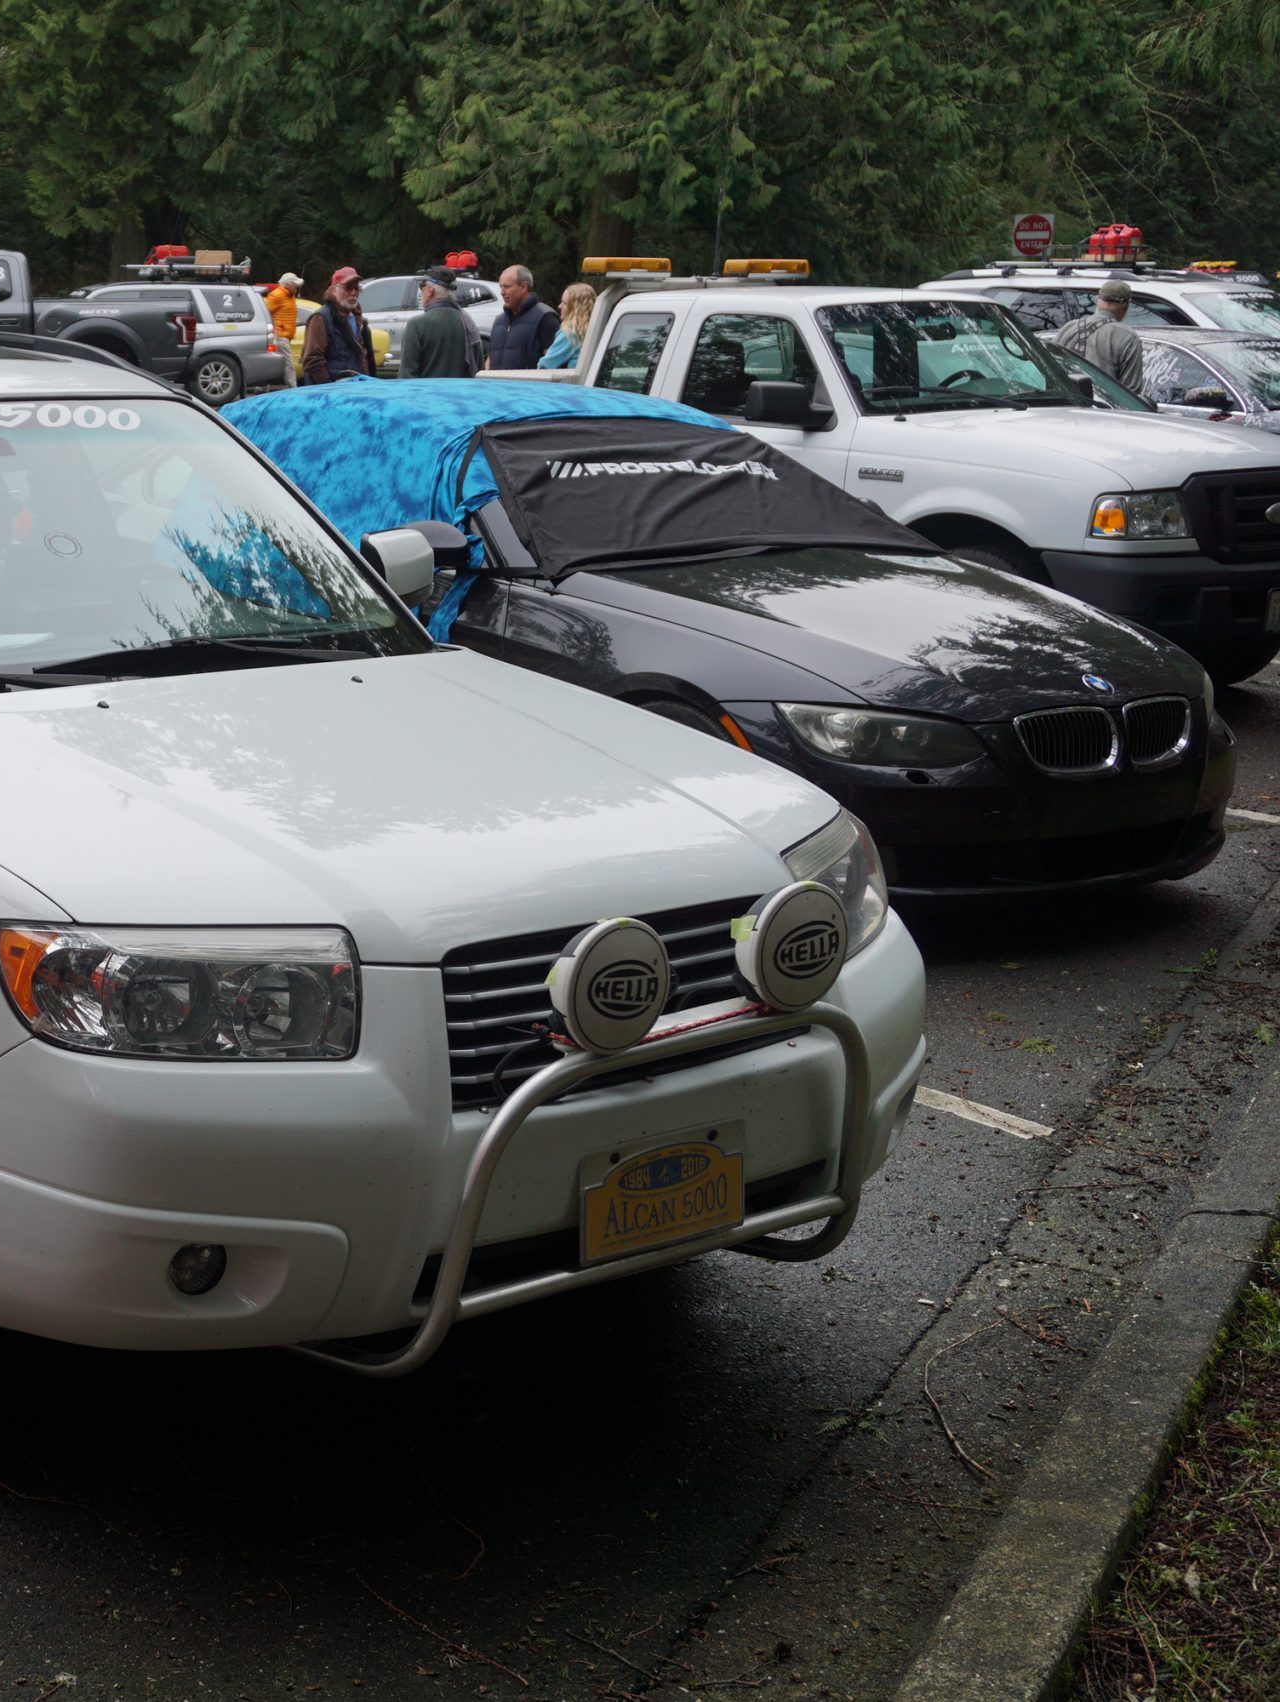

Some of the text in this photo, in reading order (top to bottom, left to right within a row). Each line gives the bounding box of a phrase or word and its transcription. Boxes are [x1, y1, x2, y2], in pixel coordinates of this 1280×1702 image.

[1033, 222, 1048, 230] NOT
[1236, 275, 1260, 283] 5000
[469, 287, 481, 298] 11
[222, 294, 233, 306] 2
[951, 343, 999, 353] Alcan
[780, 930, 840, 964] HELLA
[594, 977, 658, 1002] HELLA
[623, 1165, 652, 1188] 1984
[603, 1197, 677, 1238] ALCAN
[682, 1173, 728, 1219] 5000
